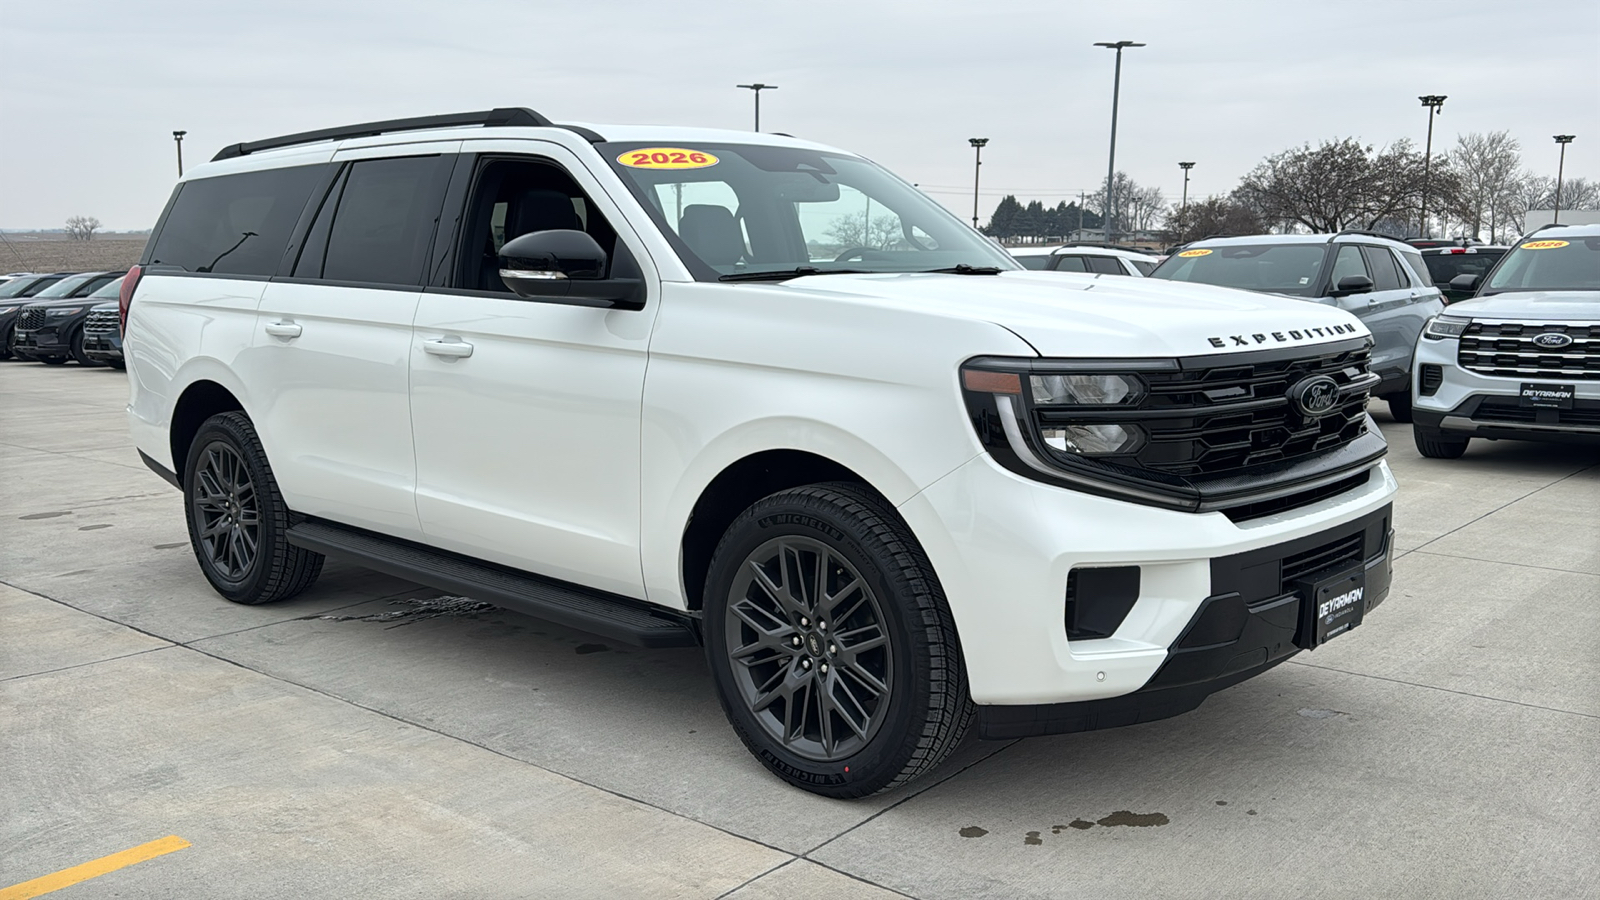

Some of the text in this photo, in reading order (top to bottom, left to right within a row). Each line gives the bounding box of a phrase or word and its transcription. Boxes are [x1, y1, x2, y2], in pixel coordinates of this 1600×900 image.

[631, 152, 708, 165] 2026
[1525, 241, 1565, 249] 2026
[1207, 323, 1357, 348] EXPEDITION
[1522, 389, 1572, 399] DEYARMAN
[776, 514, 841, 539] MICHELIN
[1319, 586, 1364, 619] DEYARMAN
[764, 752, 825, 784] MICHELIN
